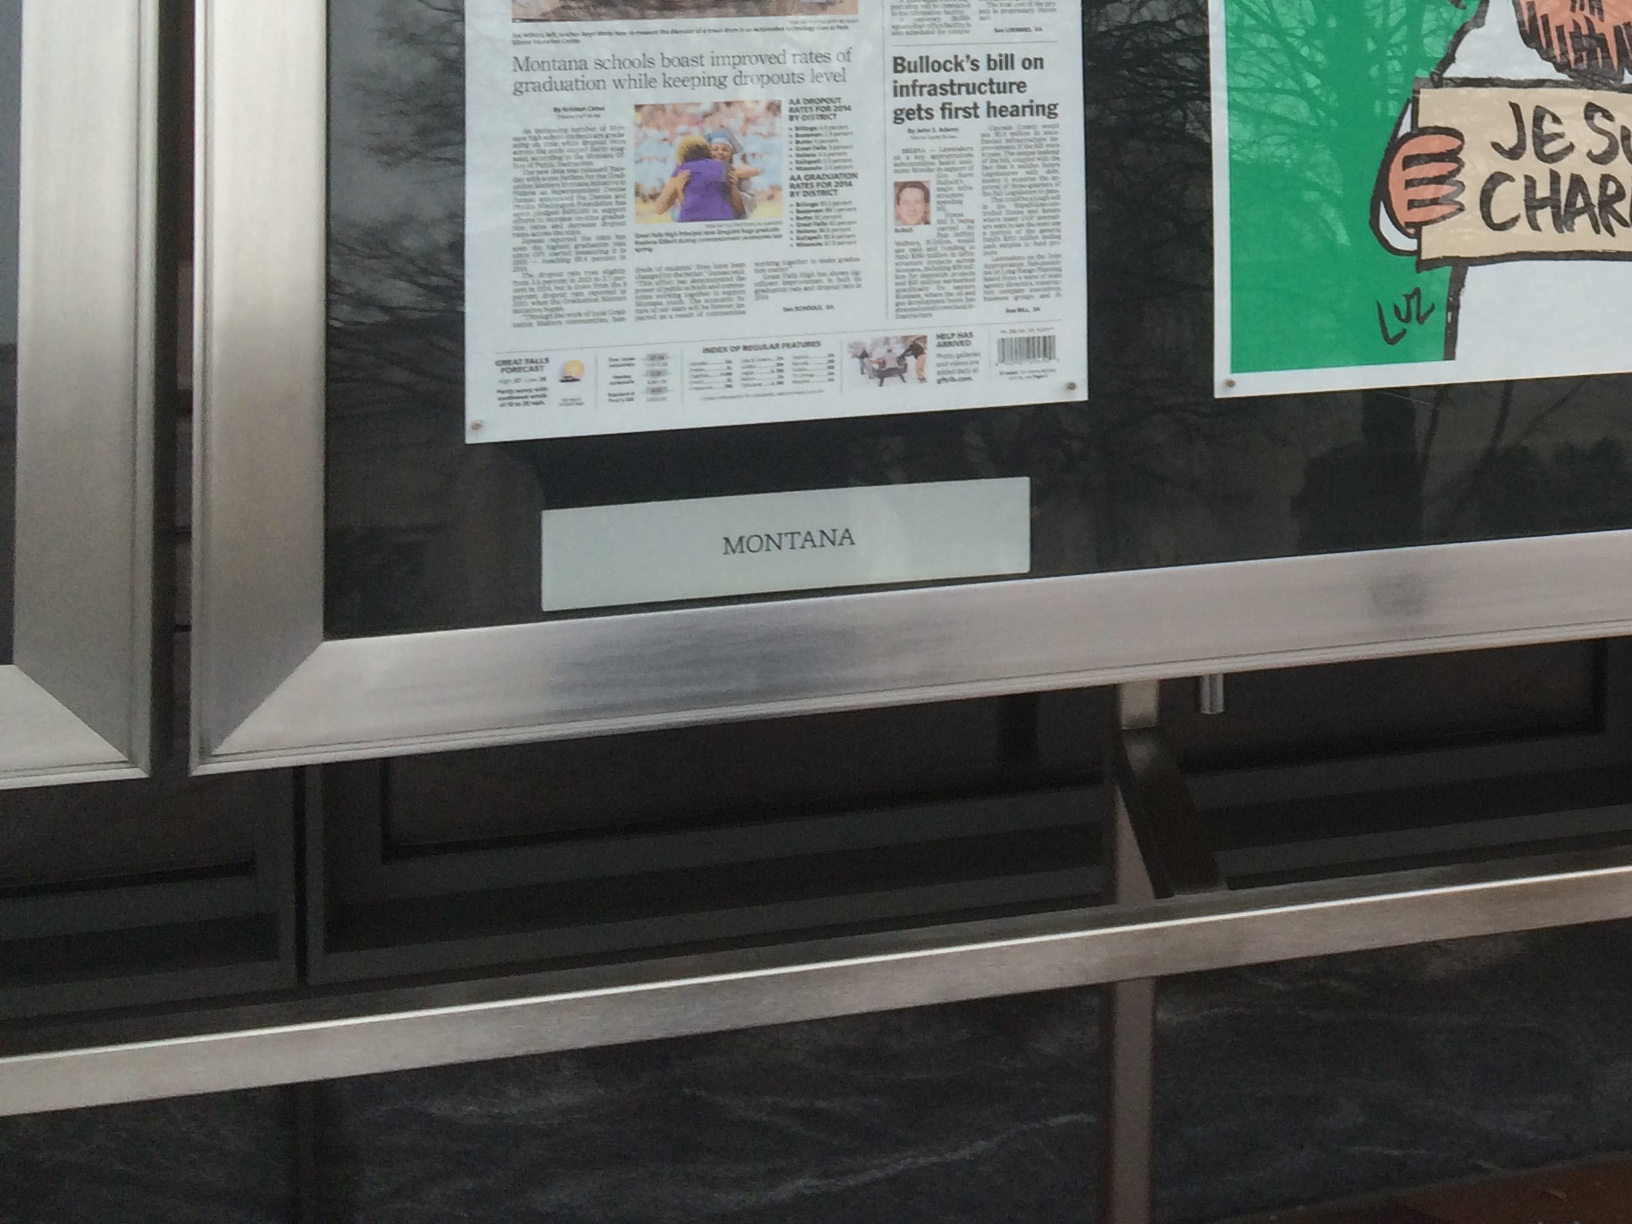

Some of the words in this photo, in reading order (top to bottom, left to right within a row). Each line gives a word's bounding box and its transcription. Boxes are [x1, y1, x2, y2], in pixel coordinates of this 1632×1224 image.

[512, 56, 589, 72] Montana
[594, 53, 655, 70] schools
[660, 52, 705, 68] boast
[710, 50, 787, 69] improved
[792, 51, 831, 69] rates
[836, 47, 853, 69] of
[893, 55, 980, 74] Bullock's
[986, 53, 1015, 71] bill
[1021, 57, 1044, 70] on
[512, 75, 607, 96] graduation
[612, 73, 658, 89] while
[662, 72, 729, 90] keeping
[732, 68, 805, 88] dropouts
[810, 67, 847, 83] level
[893, 78, 1027, 97] infrastructure
[893, 104, 935, 125] gets
[940, 102, 980, 119] first
[986, 100, 1059, 119] hearing
[1491, 101, 1575, 163] JE
[723, 529, 855, 554] MONTANA
